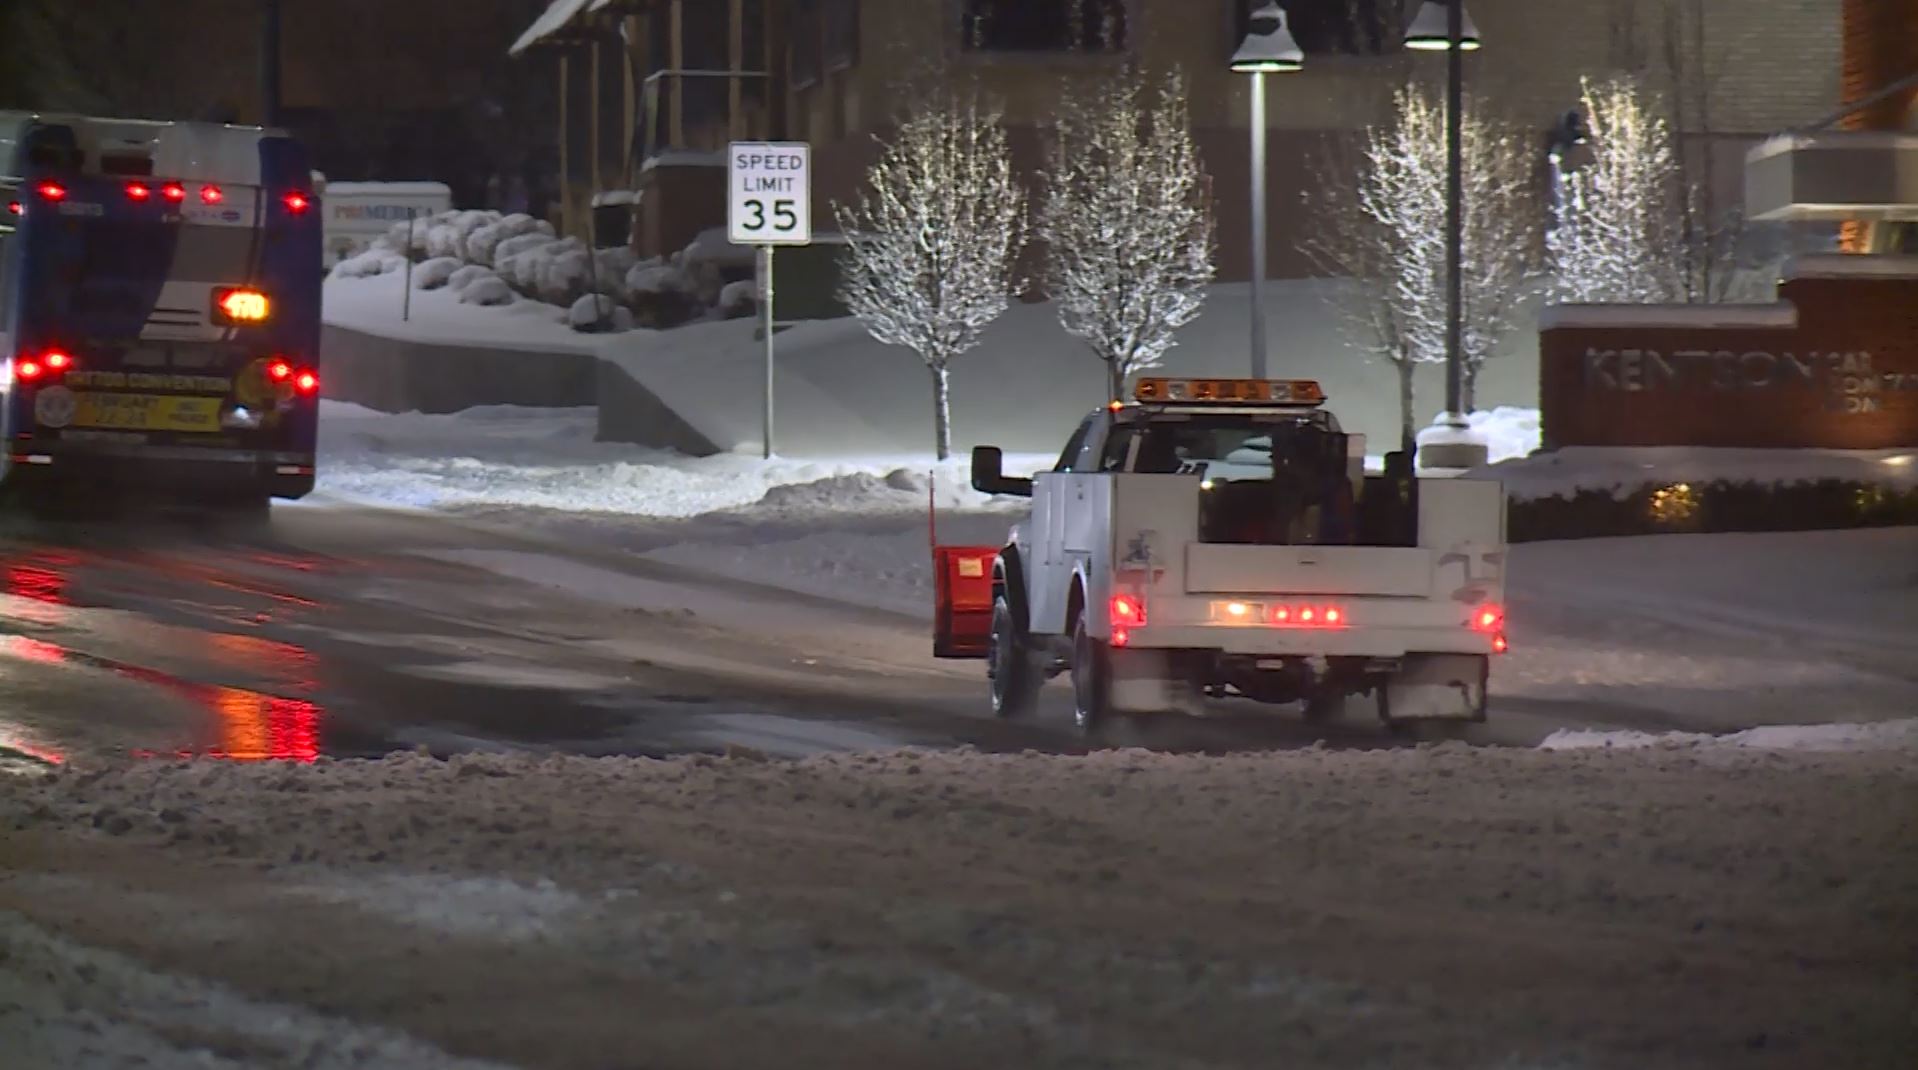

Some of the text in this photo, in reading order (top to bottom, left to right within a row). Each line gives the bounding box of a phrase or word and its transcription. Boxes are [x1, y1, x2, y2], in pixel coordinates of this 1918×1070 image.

[736, 154, 803, 170] SPEED
[743, 177, 795, 192] LIMIT
[742, 199, 798, 231] 35
